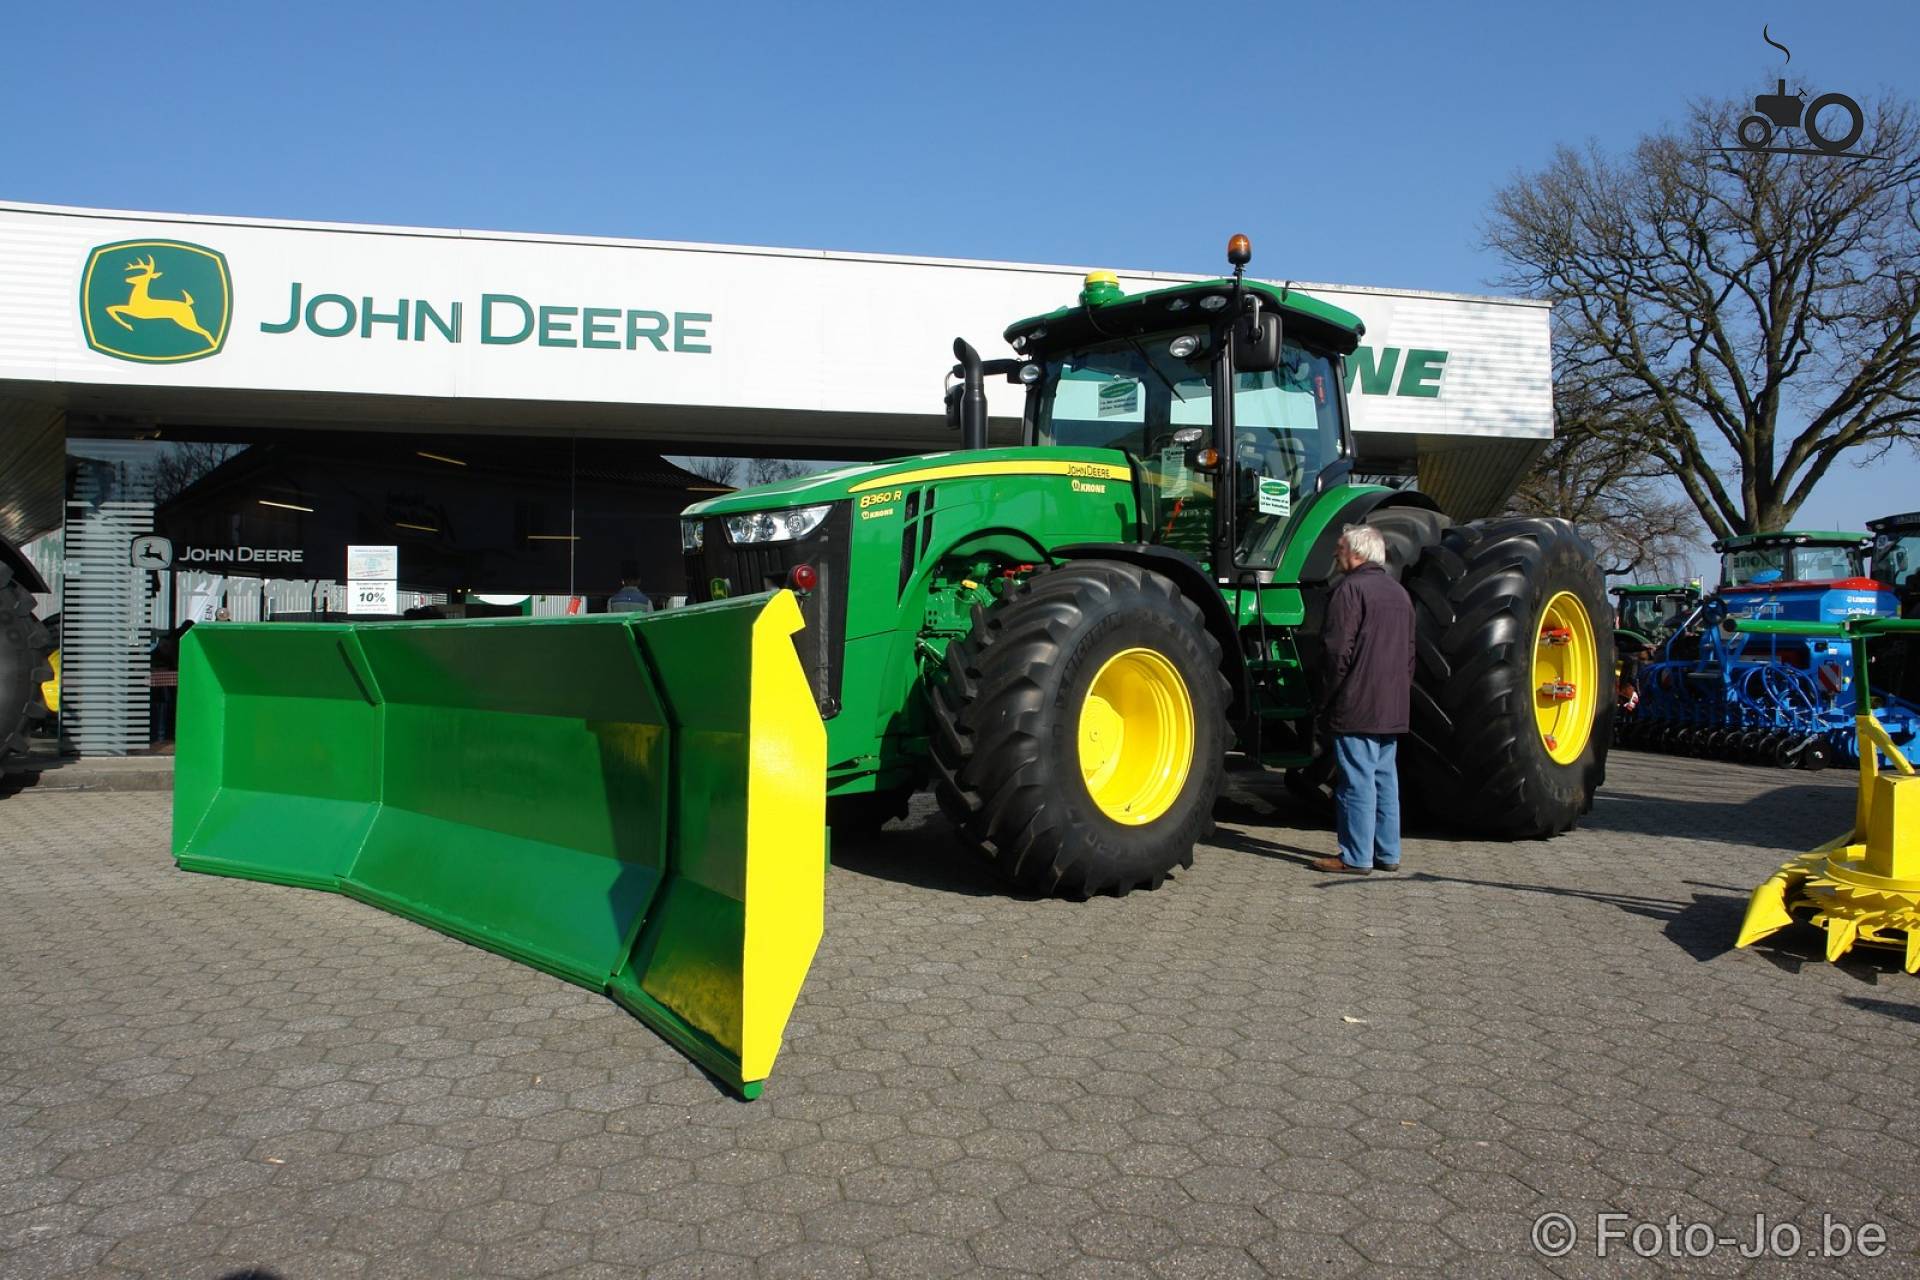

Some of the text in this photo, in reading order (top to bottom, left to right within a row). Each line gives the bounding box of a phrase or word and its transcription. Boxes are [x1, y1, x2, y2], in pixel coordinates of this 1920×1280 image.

[261, 282, 713, 354] JOHN DEERE
[1344, 346, 1449, 398] NE
[1066, 464, 1111, 478] JOHN DEERE
[1081, 483, 1106, 494] KRONE
[860, 490, 902, 508] 8360 R
[179, 546, 303, 563] JOHN DEERE
[359, 591, 386, 603] 10%
